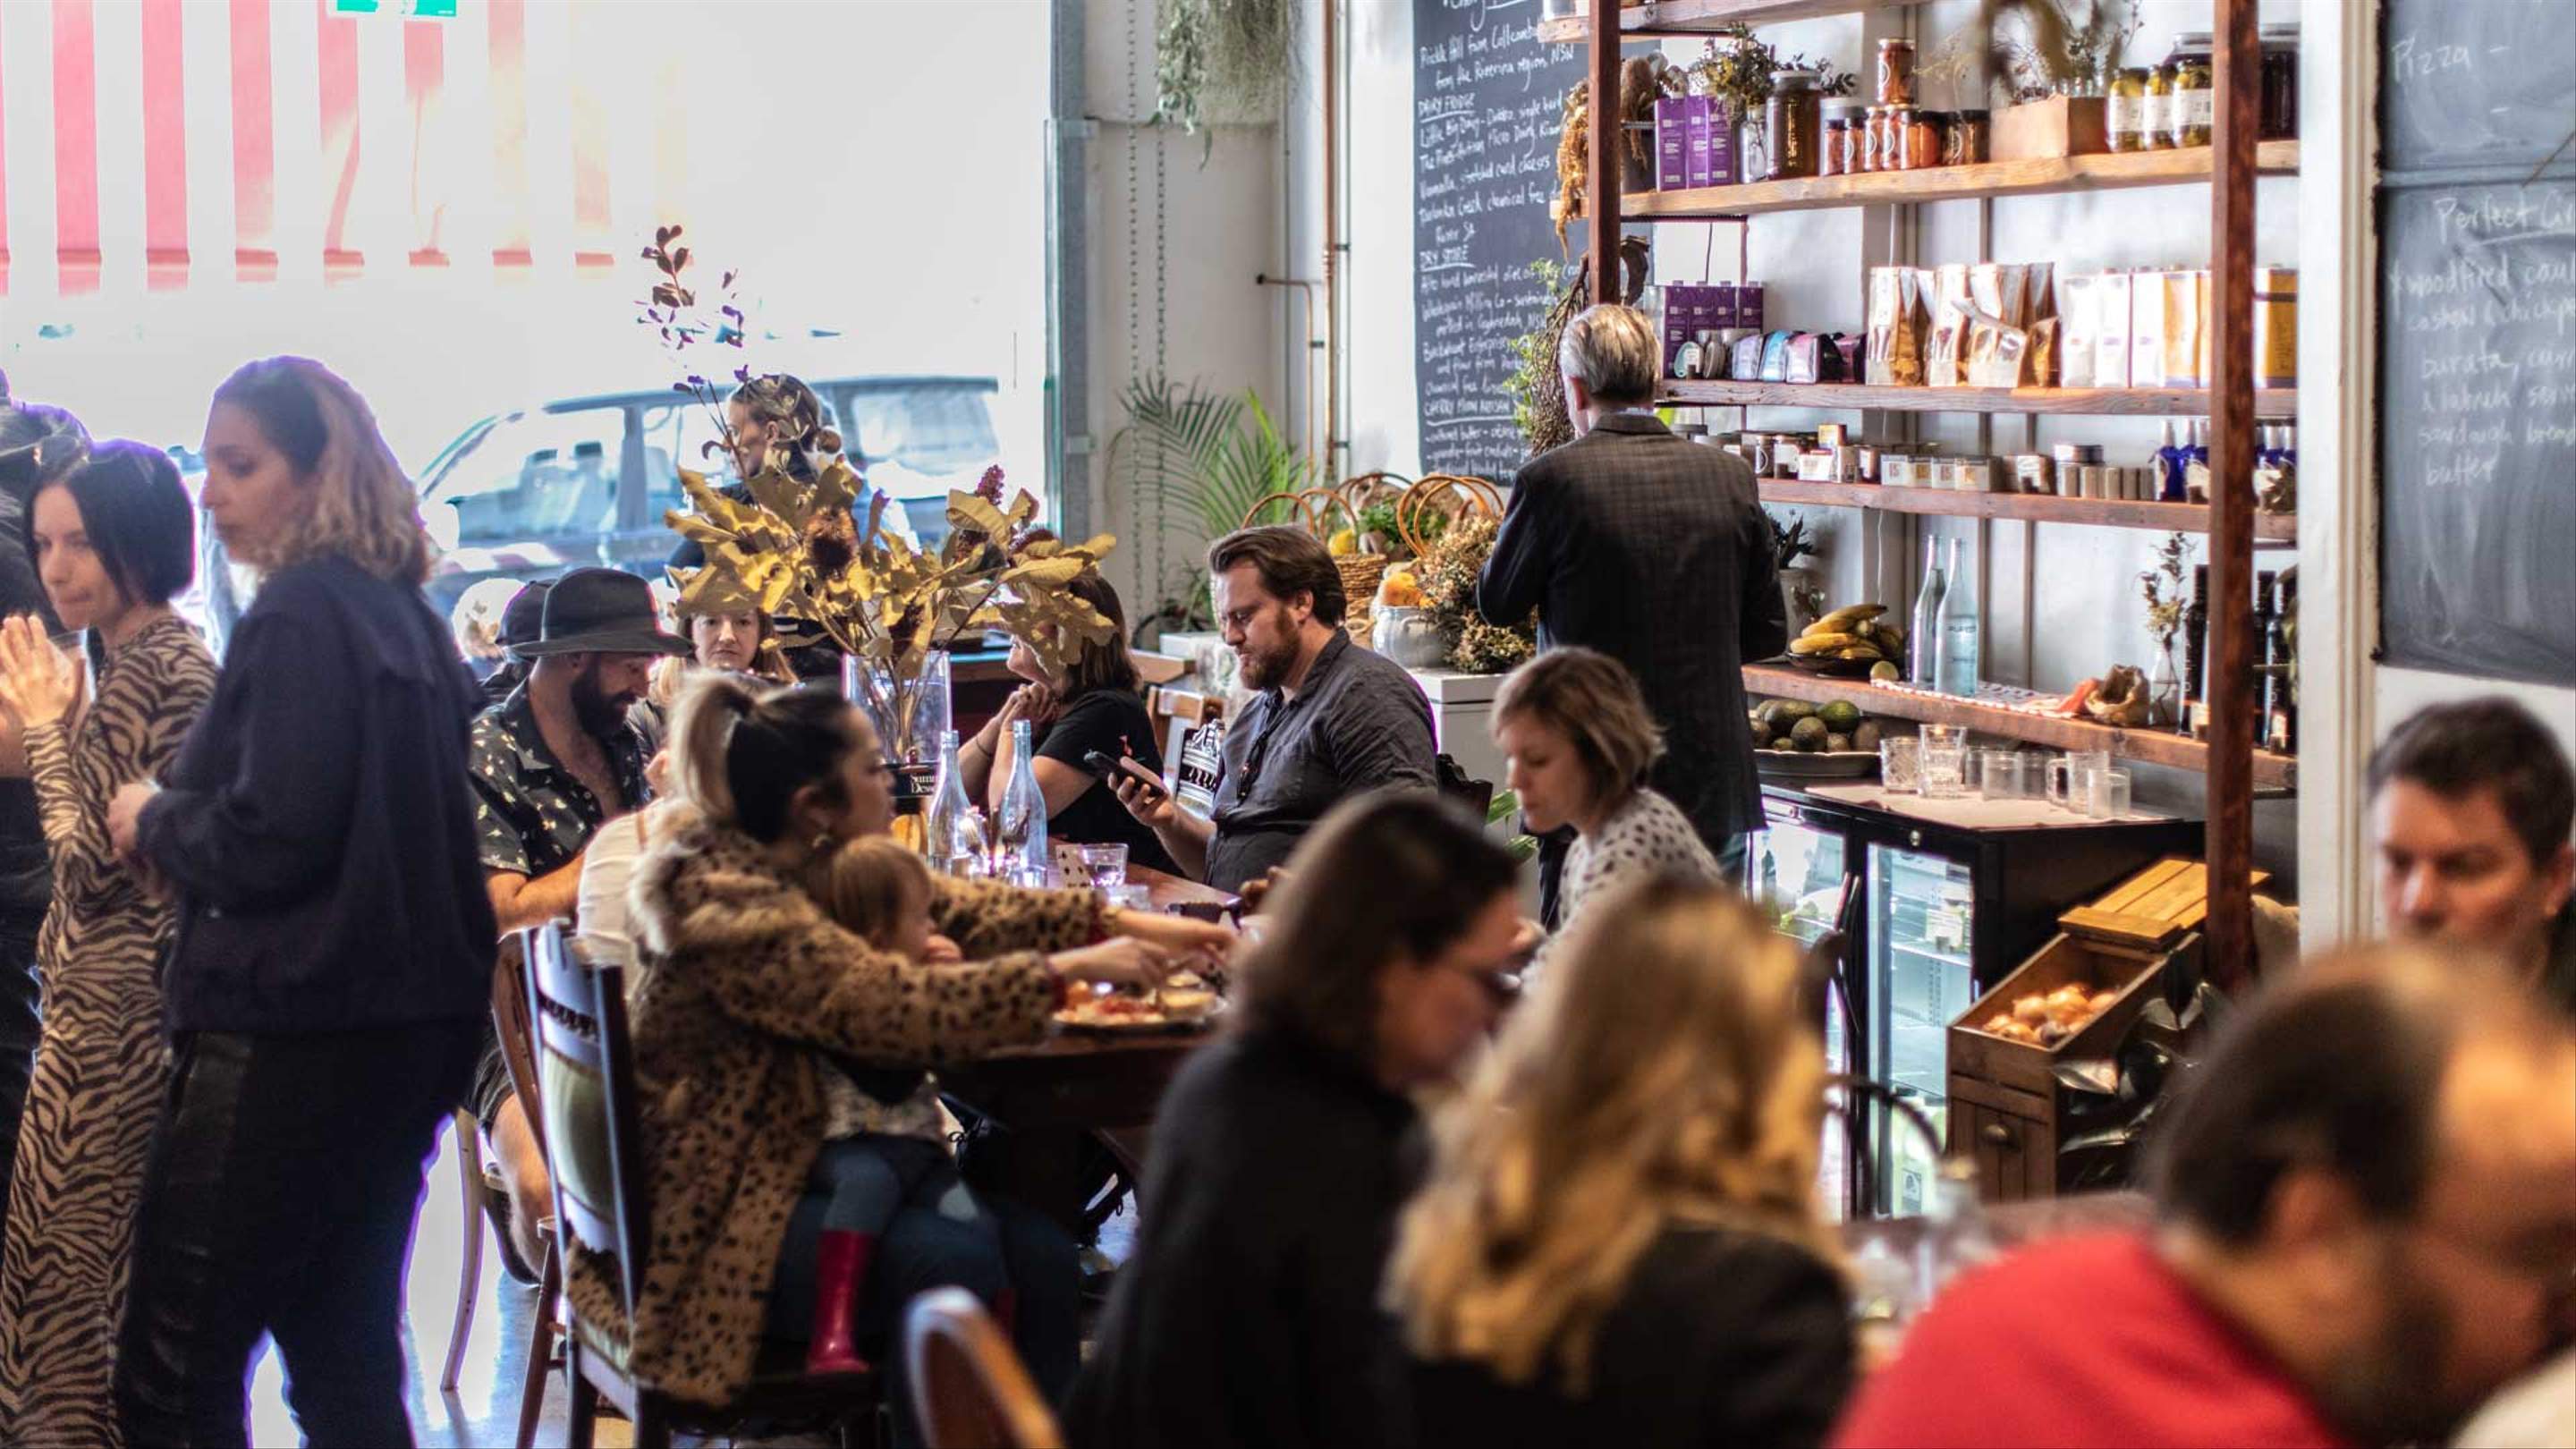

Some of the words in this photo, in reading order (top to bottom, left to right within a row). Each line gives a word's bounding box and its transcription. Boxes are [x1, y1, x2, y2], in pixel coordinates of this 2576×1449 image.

[1551, 44, 1574, 64] NSW
[2391, 37, 2472, 83] Pizza
[1487, 185, 1525, 211] chemical
[2434, 192, 2539, 245] Perfect
[2425, 451, 2494, 487] butter
